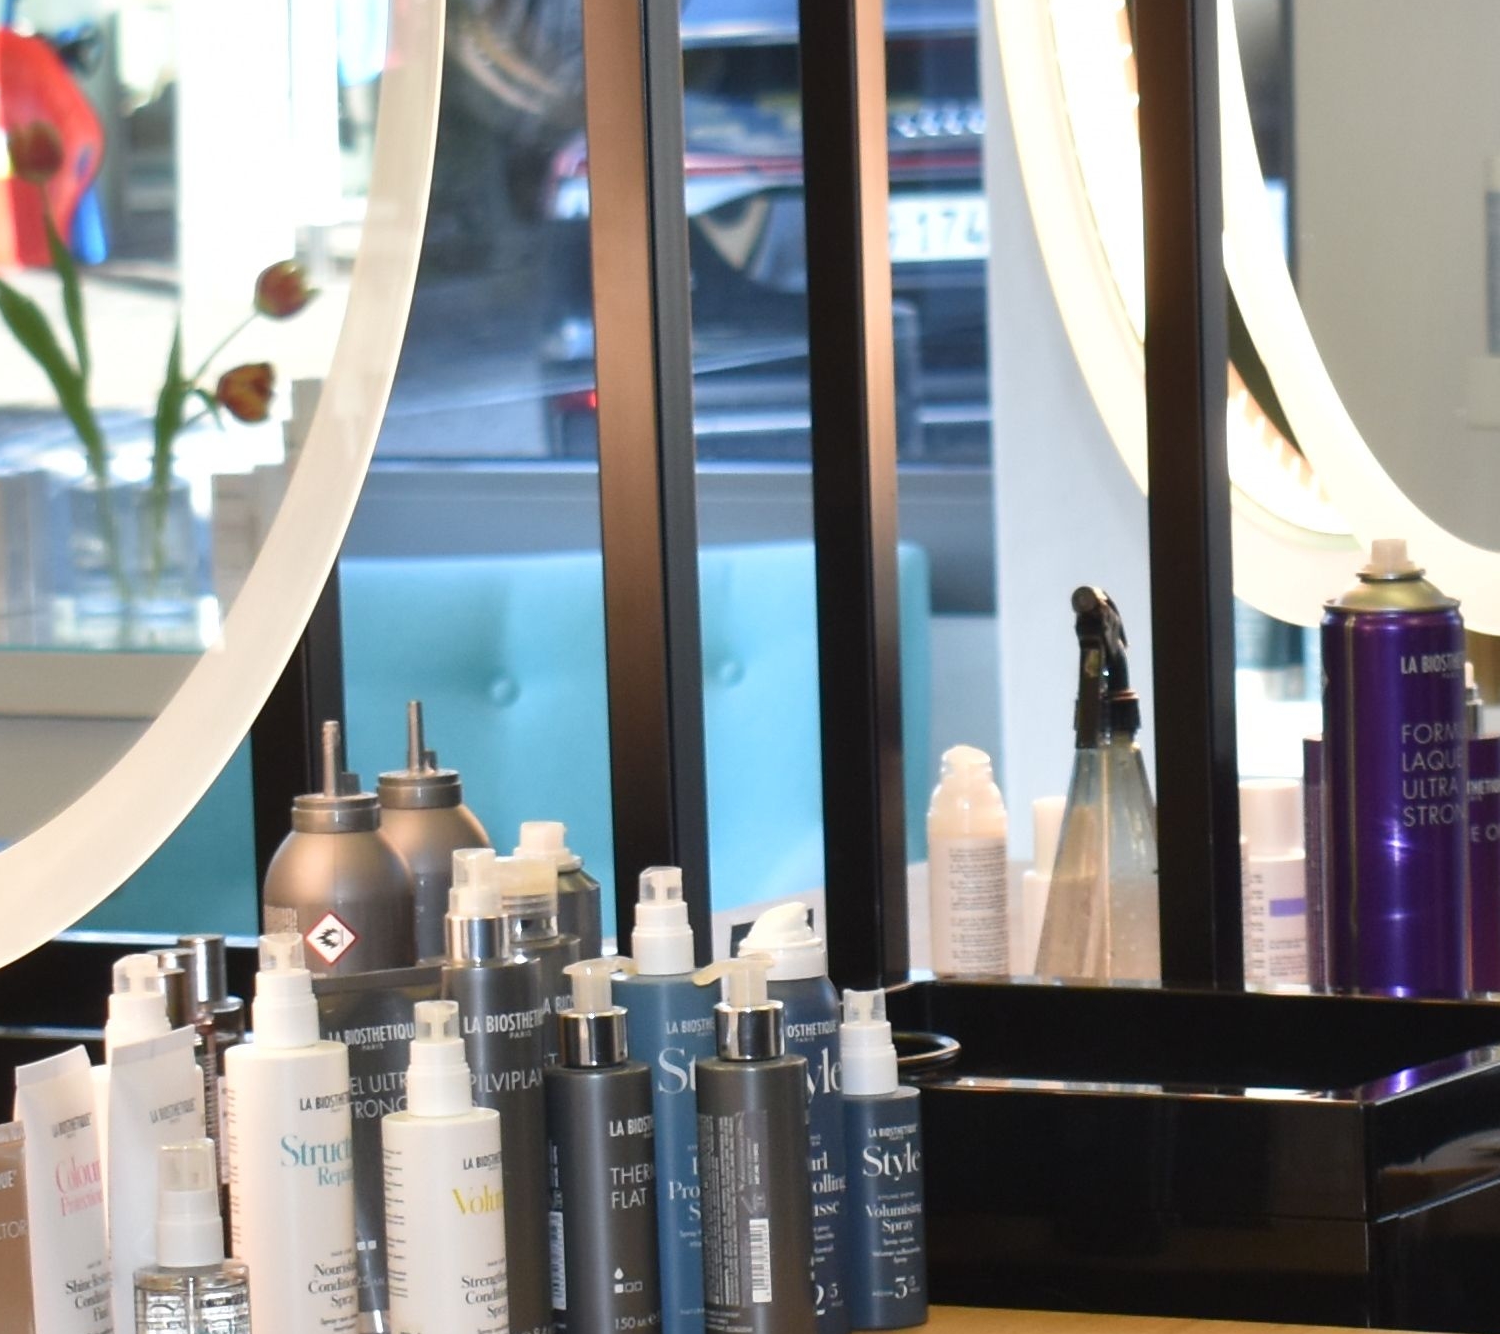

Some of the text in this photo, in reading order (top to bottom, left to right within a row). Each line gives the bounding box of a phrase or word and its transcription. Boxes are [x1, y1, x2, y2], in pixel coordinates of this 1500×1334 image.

[1402, 777, 1458, 799] ULTRA
[344, 1021, 415, 1046] BIOSTHETIQU
[463, 1016, 481, 1035] LA
[666, 1019, 679, 1035] LA
[370, 1070, 409, 1094] ULTR
[300, 1097, 312, 1111] LA
[610, 1119, 624, 1138] LA
[463, 1157, 474, 1170] LA
[862, 1141, 921, 1181] Style
[611, 1187, 648, 1209] FLAT
[613, 1317, 636, 1331] 150
